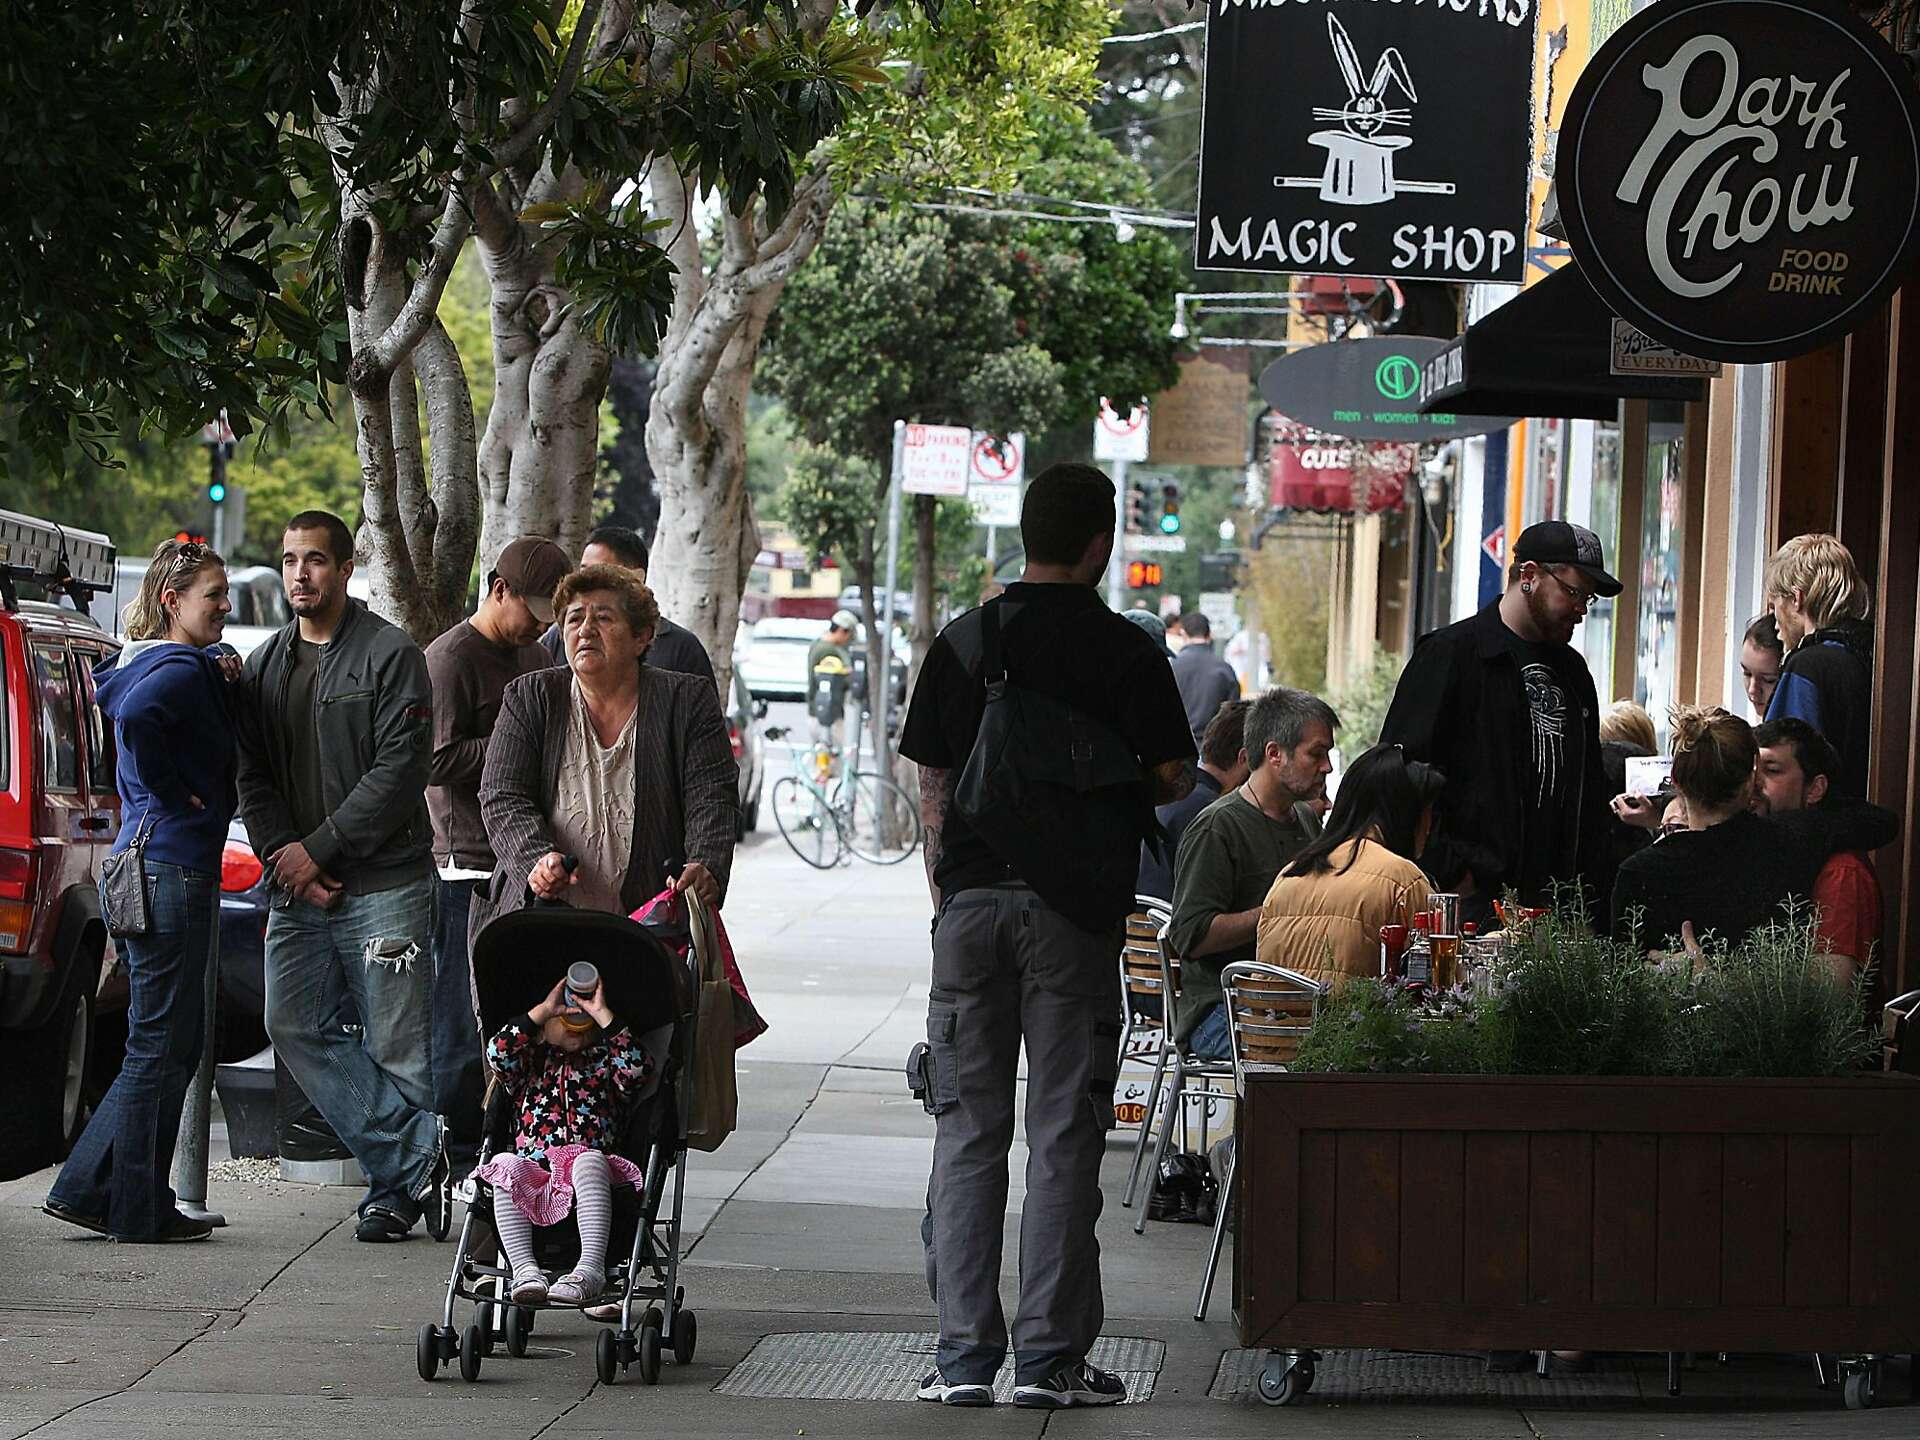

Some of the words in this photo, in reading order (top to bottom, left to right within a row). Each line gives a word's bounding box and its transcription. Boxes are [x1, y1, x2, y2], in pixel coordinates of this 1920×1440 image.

[1616, 34, 1851, 204] Park
[1646, 124, 1859, 298] Chow
[1208, 216, 1357, 266] MAGIC
[1391, 224, 1516, 272] SHOP
[1780, 249, 1849, 272] FOOD
[1768, 272, 1842, 295] DRINK
[1621, 356, 1711, 370] EVERYDAY
[1334, 411, 1360, 422] men
[1374, 412, 1418, 424] women
[1431, 413, 1456, 425] kids
